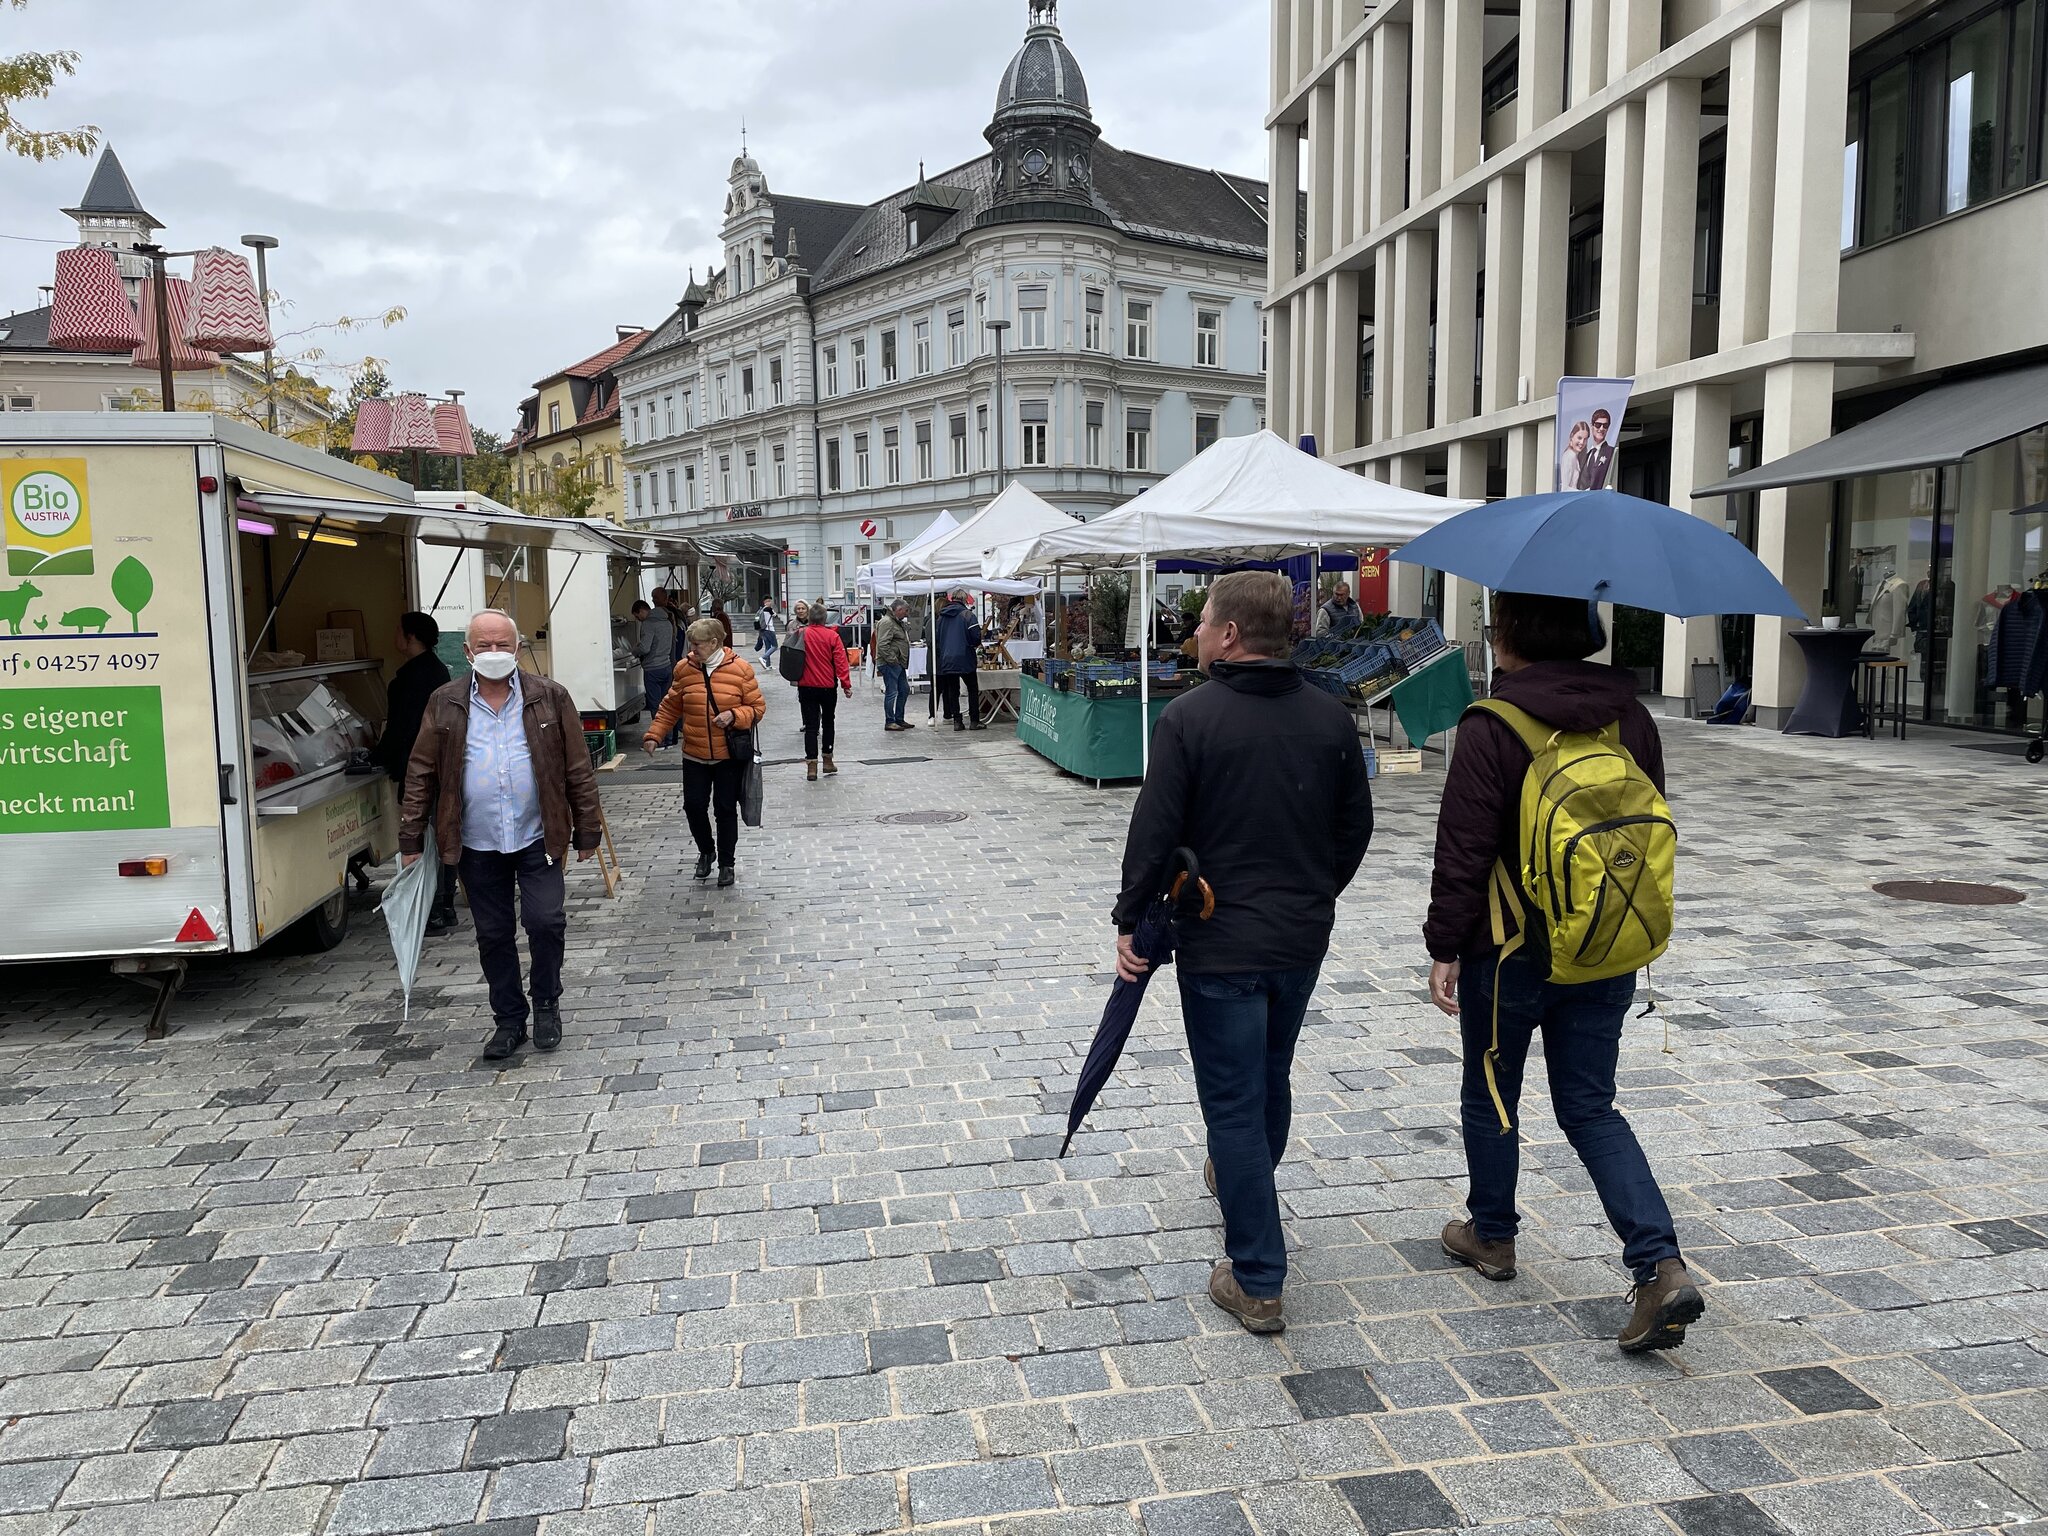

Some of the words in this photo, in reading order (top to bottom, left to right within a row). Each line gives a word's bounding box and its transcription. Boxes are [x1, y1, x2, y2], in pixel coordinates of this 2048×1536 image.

[23, 484, 69, 510] Bio
[24, 511, 70, 521] AUSTRIA
[731, 506, 744, 519] Bank
[1361, 565, 1380, 578] STERN
[0, 653, 21, 676] rf
[36, 654, 100, 672] 04257
[106, 653, 160, 671] 4097
[23, 706, 128, 735] eigener
[72, 789, 136, 813] man!
